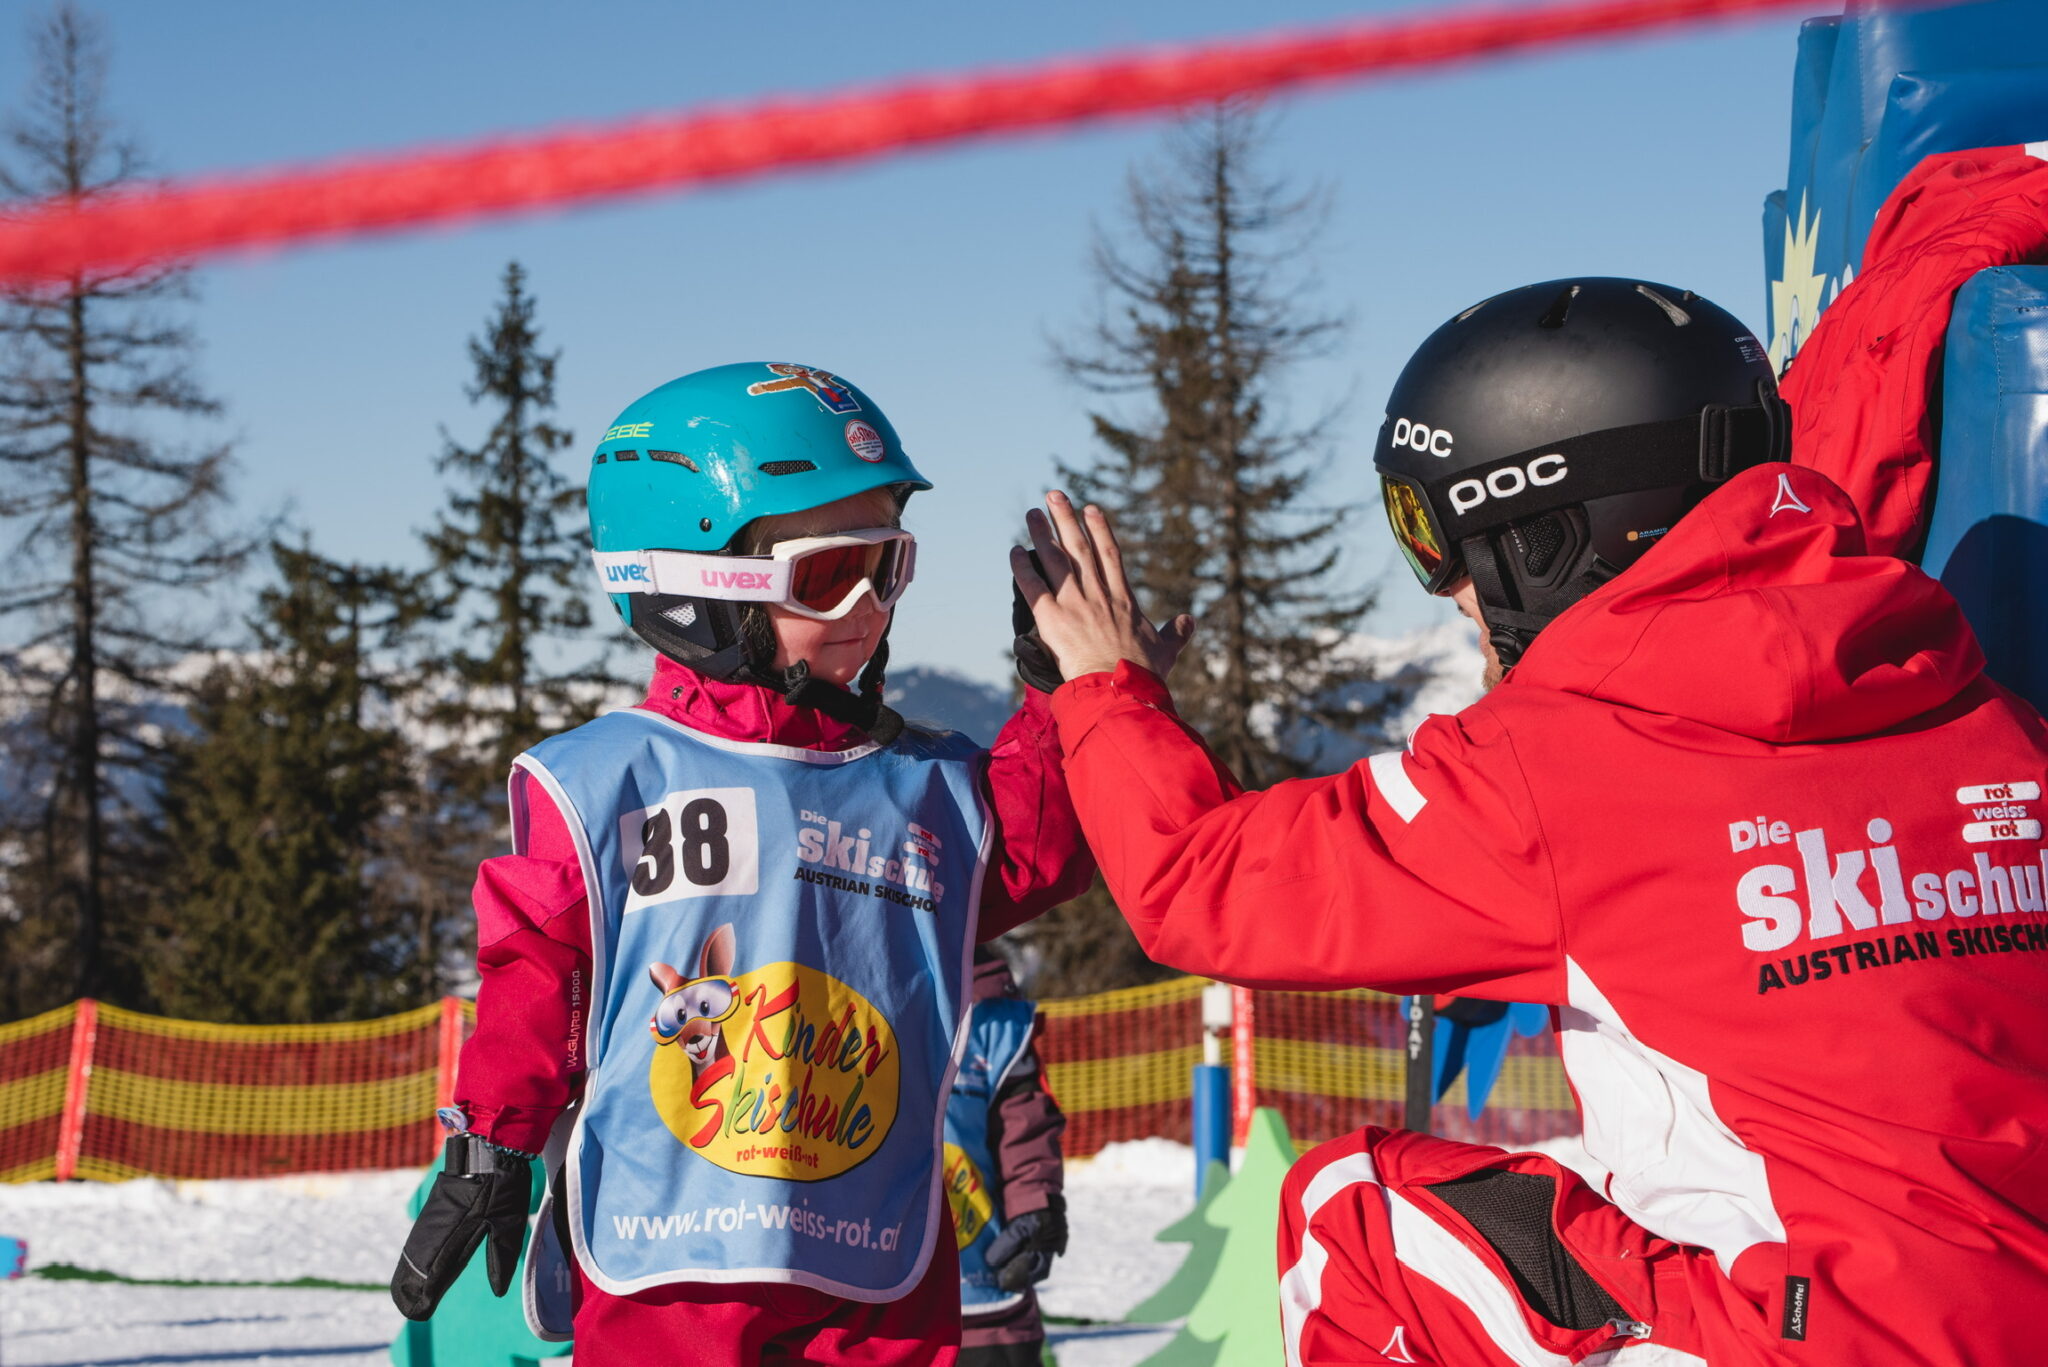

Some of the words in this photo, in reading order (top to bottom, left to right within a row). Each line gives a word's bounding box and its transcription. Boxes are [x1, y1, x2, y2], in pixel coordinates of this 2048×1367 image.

[606, 564, 651, 582] uvex
[701, 569, 773, 590] uvex
[1972, 801, 2028, 820] weiss
[1984, 784, 2014, 800] rot
[800, 809, 828, 825] Die
[1729, 816, 1791, 853] Die
[1990, 820, 2020, 838] rot
[797, 820, 945, 903] skischue
[794, 866, 870, 896] AUSTRIAN
[874, 884, 938, 914] SKISCHO
[1758, 931, 1941, 994] AUSTRIAN
[1946, 922, 2048, 958] SKISCH
[567, 1010, 581, 1069] W-GUARD
[743, 976, 889, 1077] Kinder
[689, 1055, 875, 1149] Skischule
